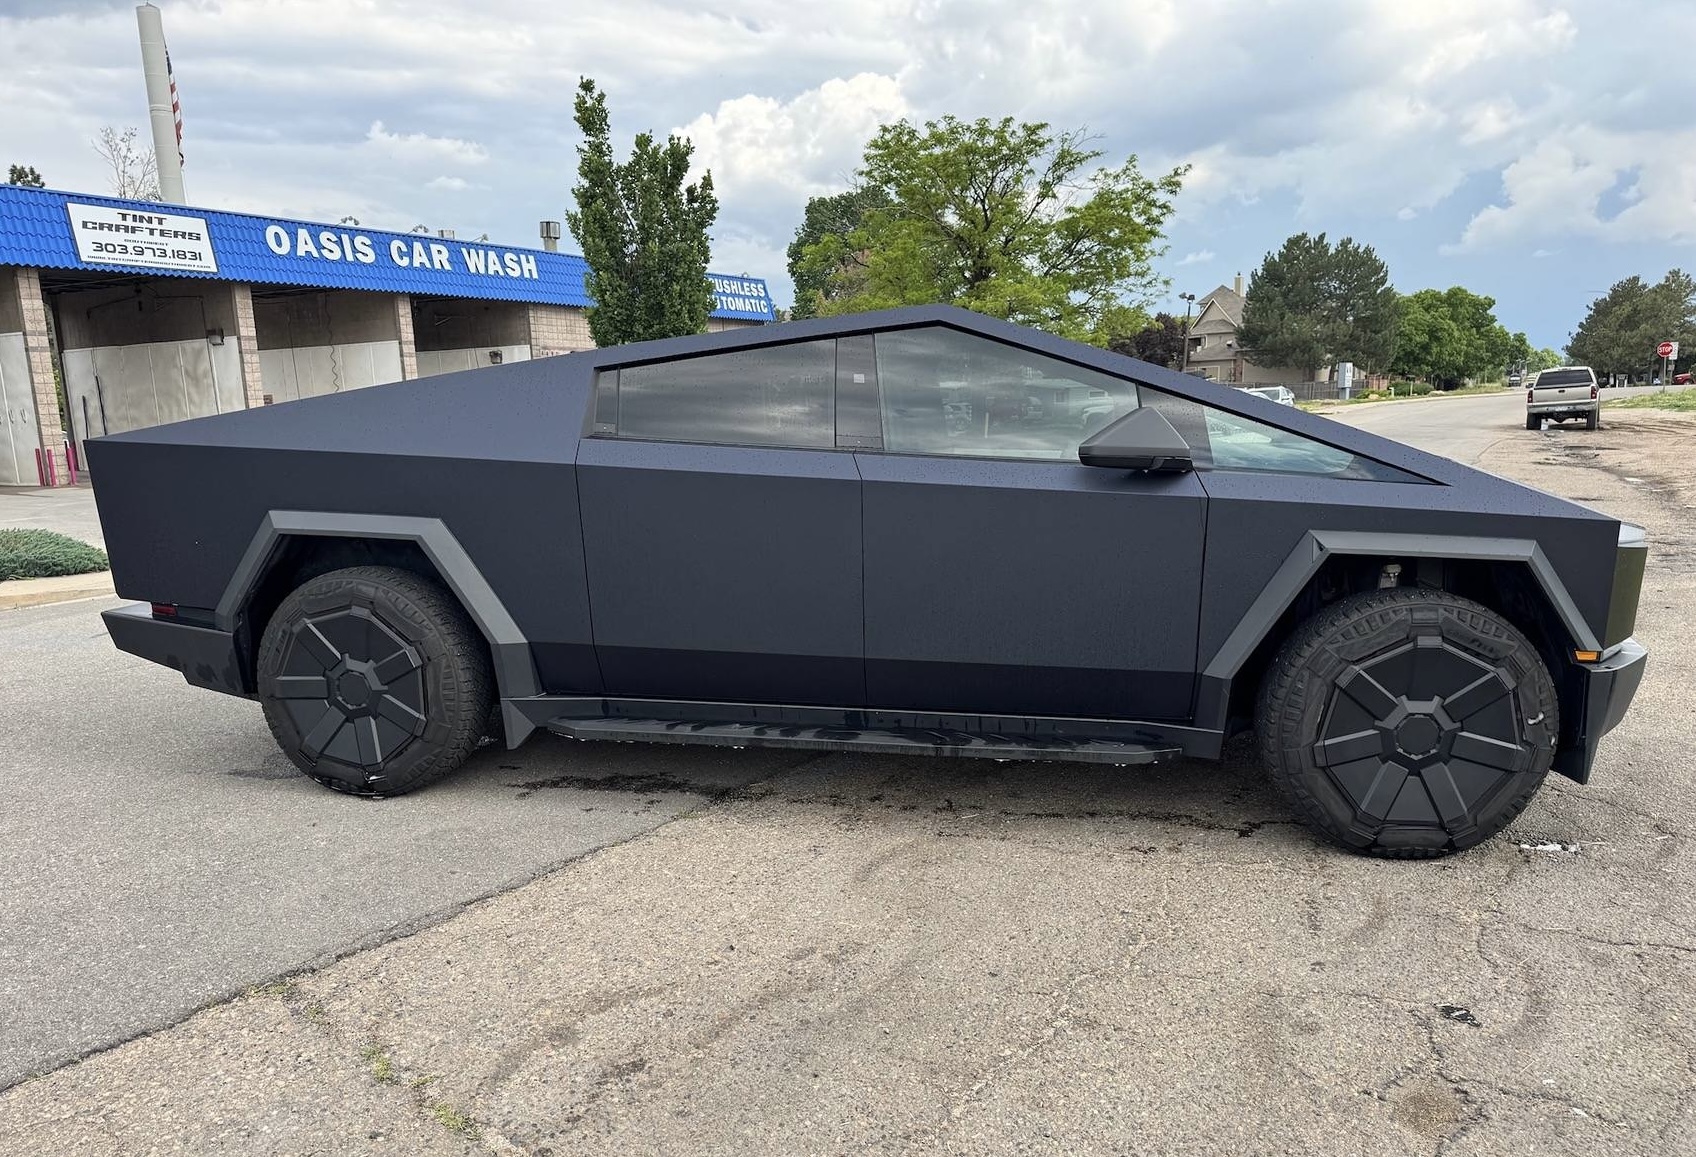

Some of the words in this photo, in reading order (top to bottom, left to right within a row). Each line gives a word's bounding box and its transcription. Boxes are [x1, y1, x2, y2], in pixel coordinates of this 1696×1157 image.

[117, 212, 167, 226] TINT
[81, 220, 201, 242] CRAFTERS
[91, 241, 203, 262] 303.973.1831
[265, 225, 376, 264] OASIS
[389, 239, 452, 271] CAR
[461, 247, 539, 280] WASH
